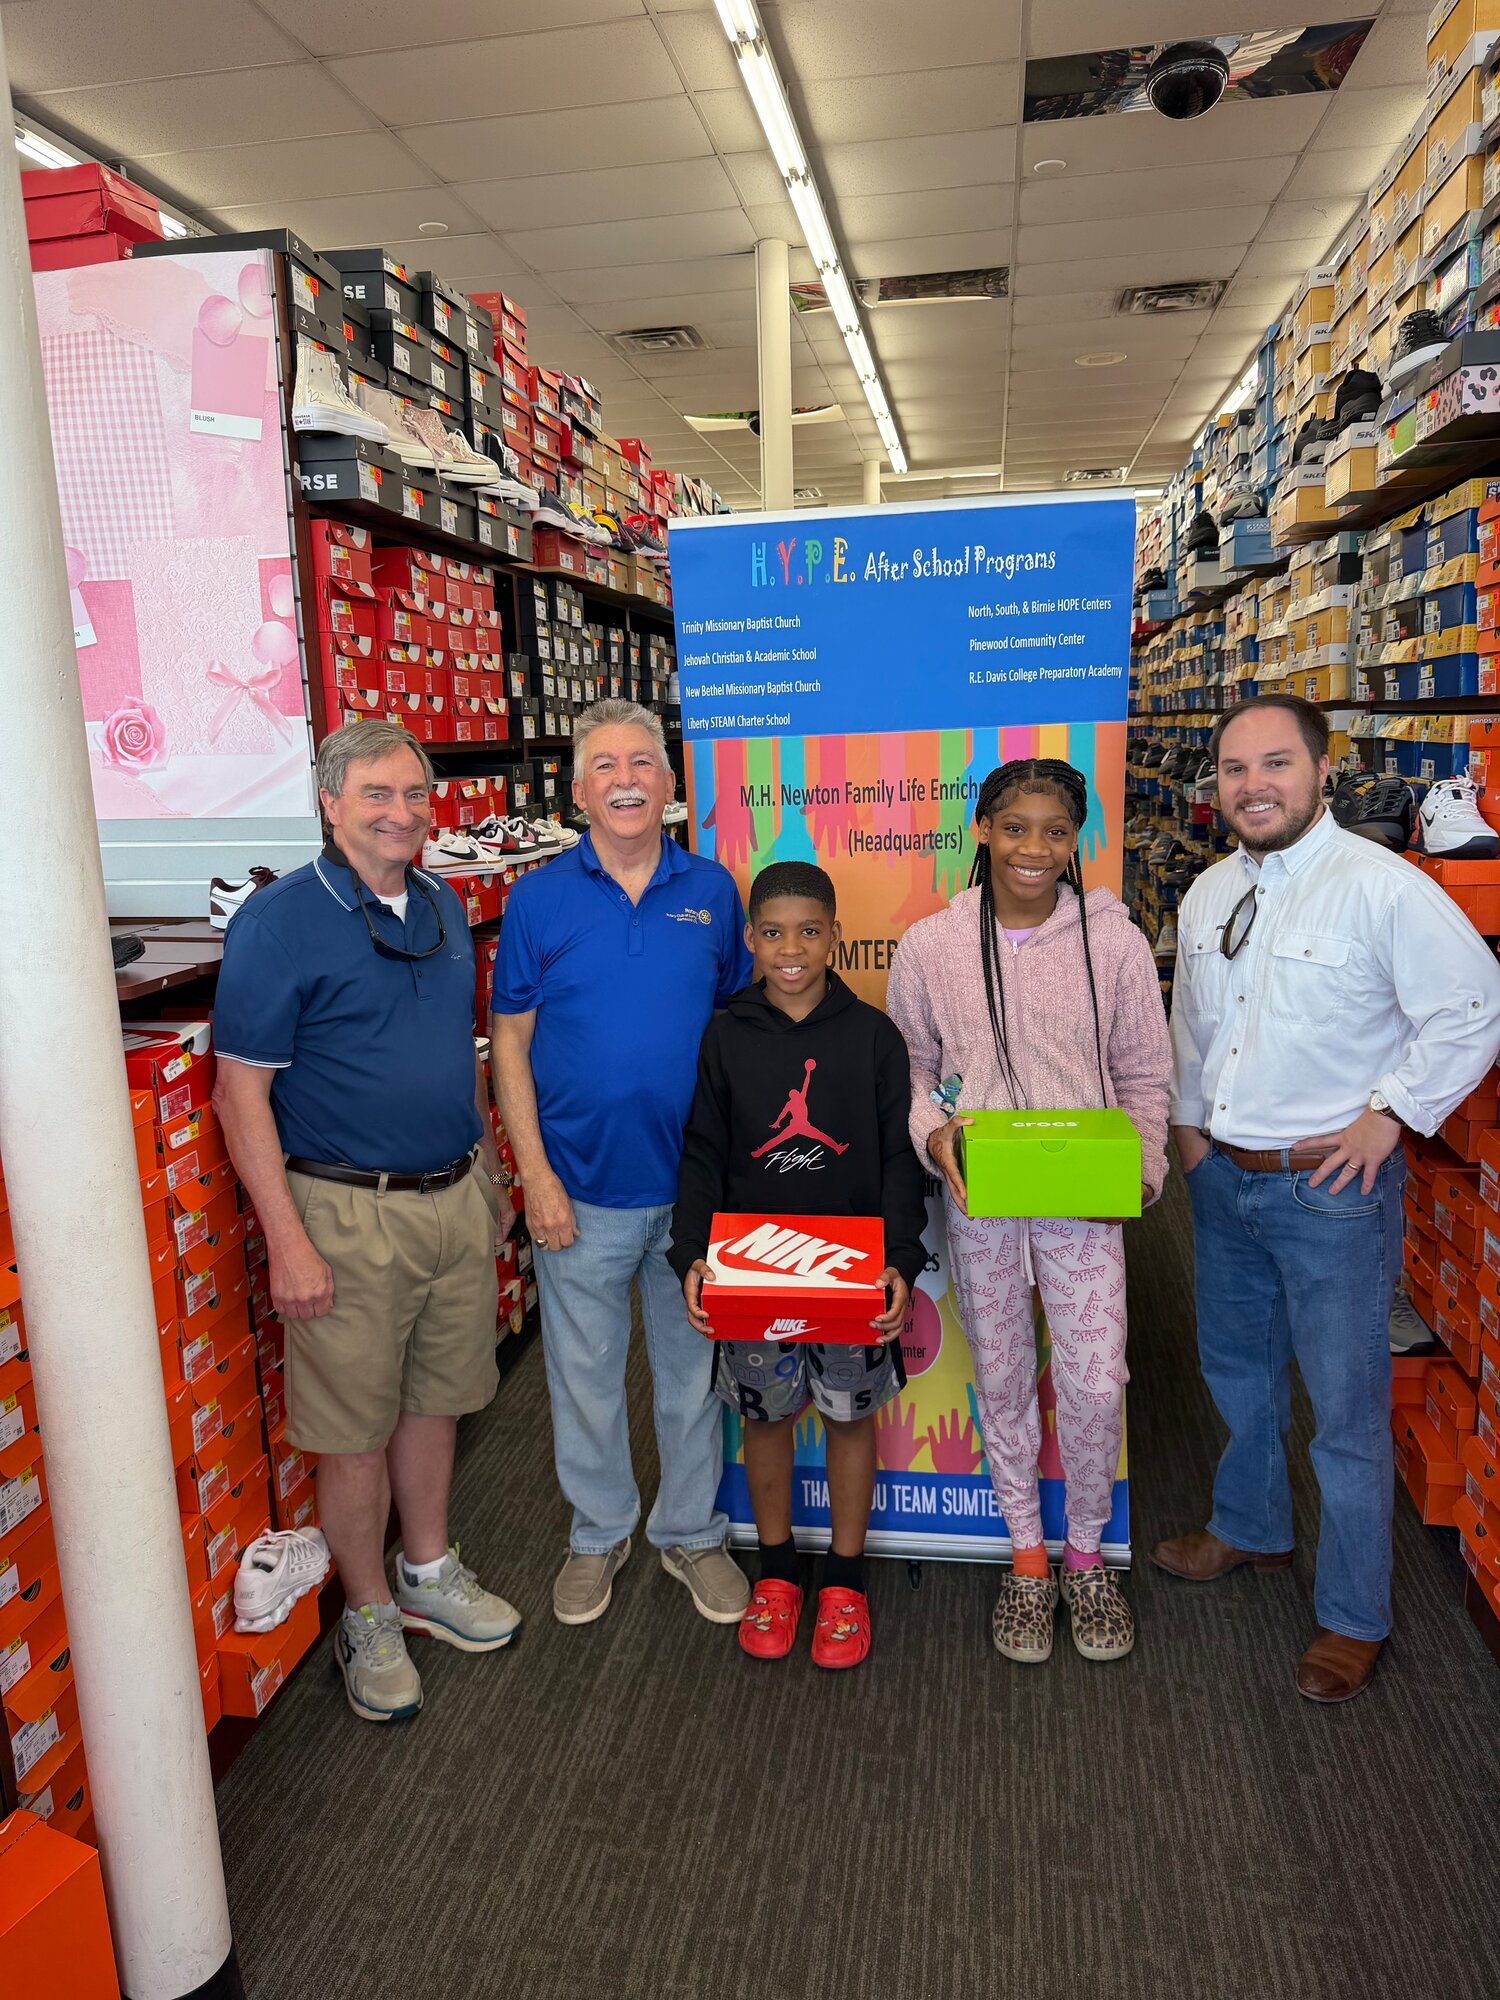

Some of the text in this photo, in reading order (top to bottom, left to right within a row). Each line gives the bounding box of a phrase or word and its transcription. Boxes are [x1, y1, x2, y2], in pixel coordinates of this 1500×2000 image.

[343, 285, 366, 299] SE
[194, 414, 215, 422] BLUSH
[300, 473, 338, 491] RSE
[752, 537, 1056, 587] H.Y.P.E. After School Programs
[968, 597, 1112, 618] North, South, & Birnie HOPE Centers
[682, 615, 801, 635] Trinity Missionary Baptist Church
[969, 633, 1086, 651] Pinewood Community Center
[684, 648, 817, 667] Jehovah Christian & Academic School
[969, 664, 1123, 683] R.E. Davis College Preparatory Academy
[685, 680, 821, 698] New Bethel Missionary Baptist Church
[669, 720, 682, 729] SE
[687, 713, 790, 730] Liberty STEAM Charter School
[740, 775, 981, 808] M.H. Newton Family Life Enrich
[848, 824, 963, 858] (Headquarters)
[764, 1144, 826, 1173] Flight
[725, 1222, 869, 1281] NIKE
[770, 1318, 808, 1332] NIKE
[904, 1320, 913, 1334] of
[801, 1479, 831, 1508] THA
[892, 1484, 937, 1515] TEAM
